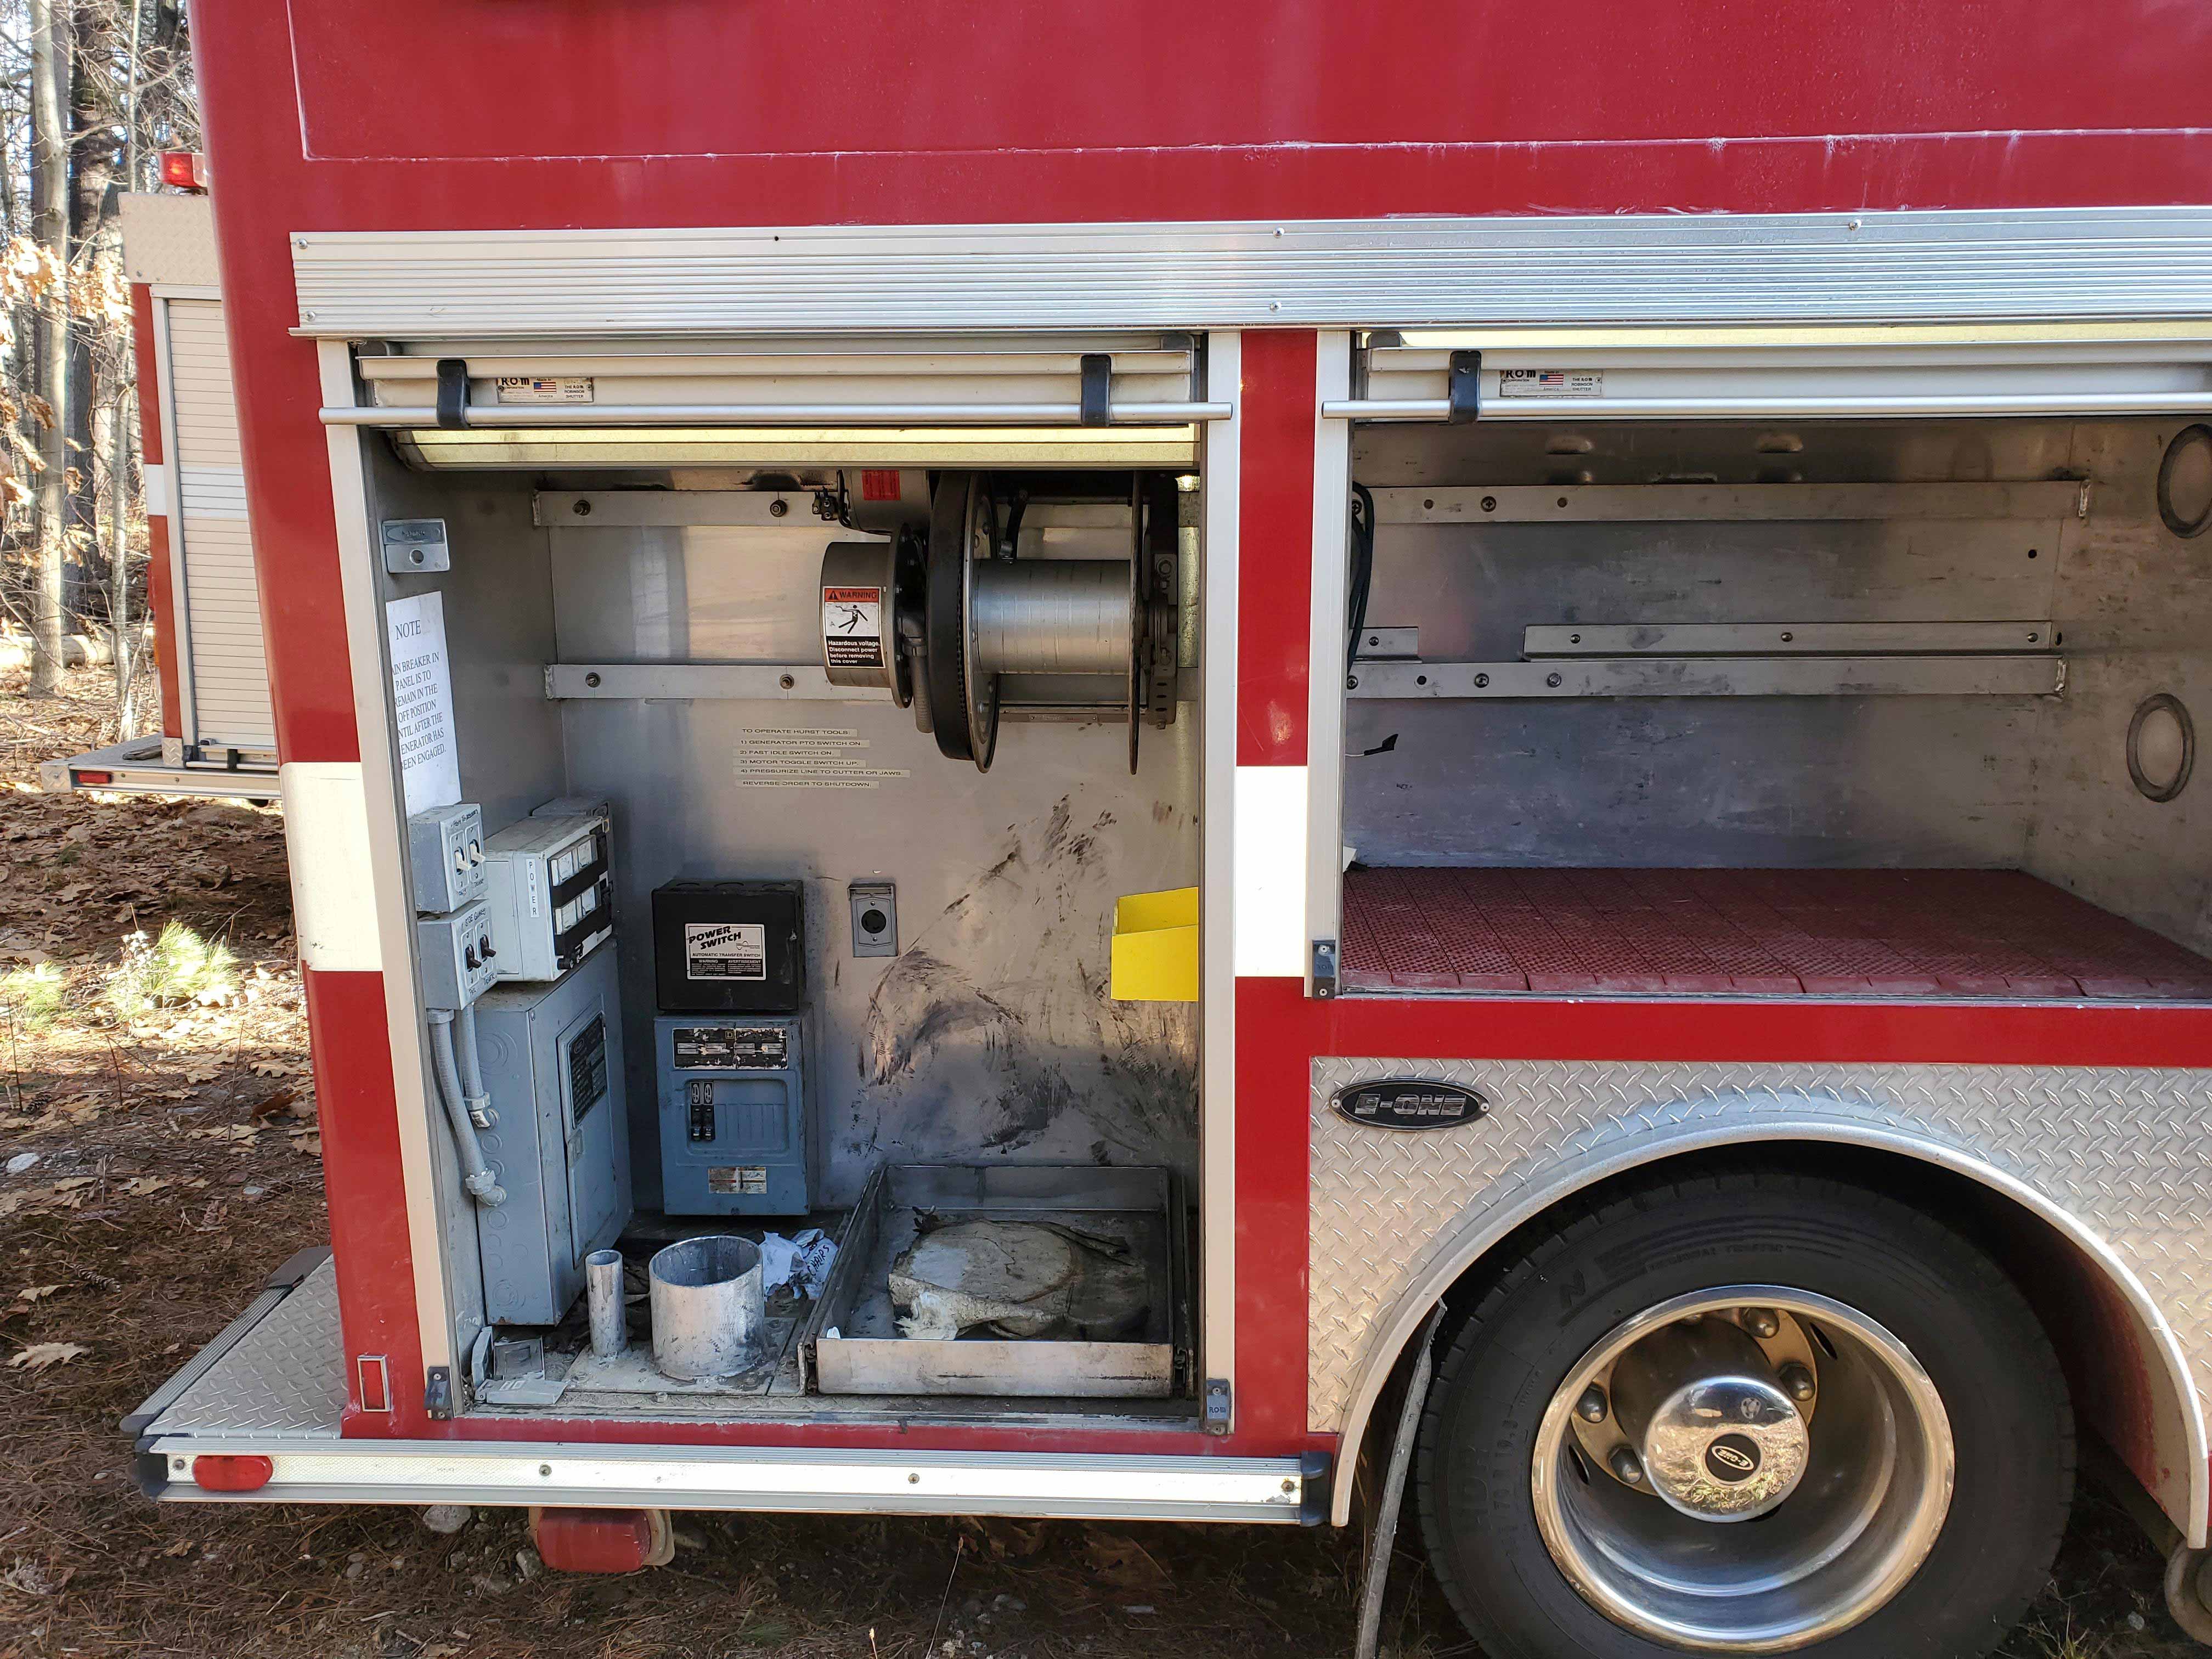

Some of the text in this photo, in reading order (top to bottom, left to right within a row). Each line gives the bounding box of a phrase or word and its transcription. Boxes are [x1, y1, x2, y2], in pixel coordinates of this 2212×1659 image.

[395, 619, 421, 640] NOTE
[402, 653, 431, 673] BREAKER
[431, 652, 440, 663] IN
[396, 669, 432, 691] PANEL IS TO
[394, 683, 438, 708] REMAIN IN THE
[398, 699, 437, 724] OFF POSITION
[398, 712, 443, 741] NTIL AFTER THE
[401, 727, 445, 755] ENERATOR HAS
[417, 743, 447, 765] ENGAGED.
[529, 861, 537, 916] POWER
[689, 926, 731, 944] POWER
[700, 932, 741, 950] SWITCH
[1355, 1093, 1466, 1115] E-ONE
[807, 1244, 830, 1276] CHAIRS
